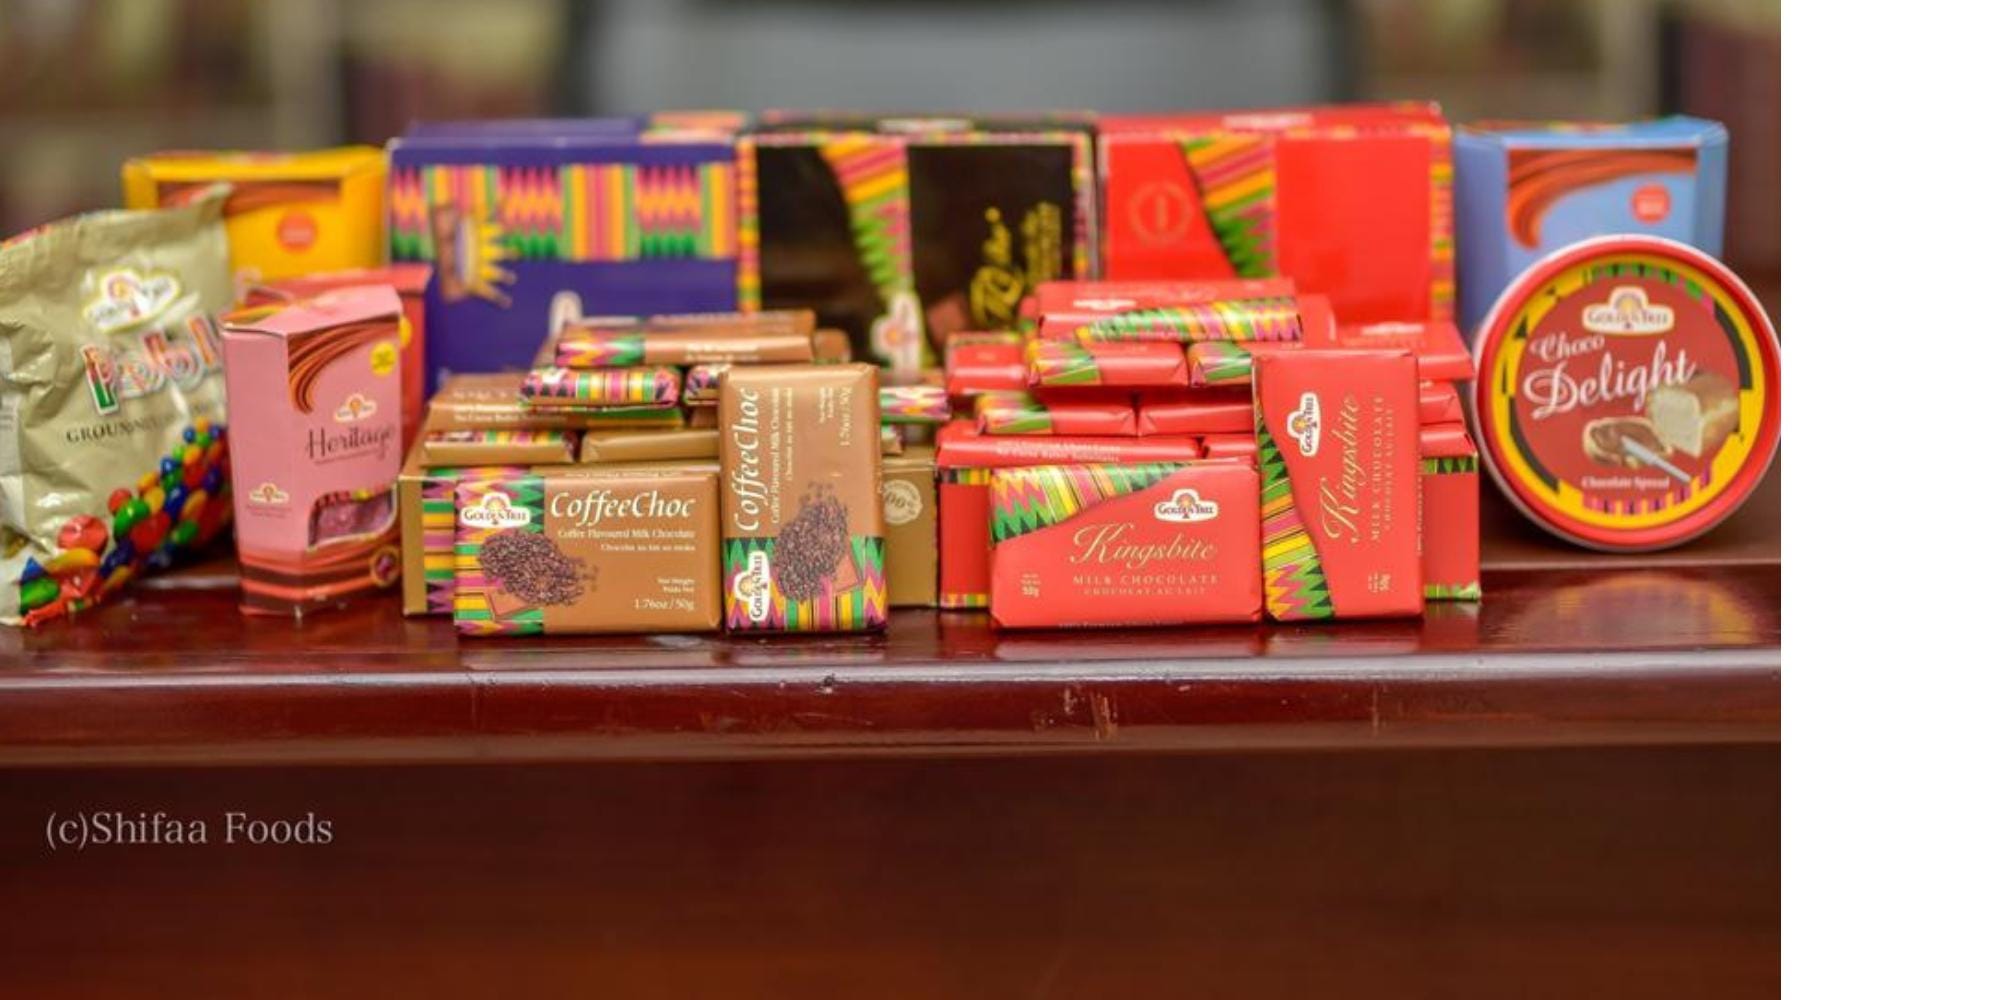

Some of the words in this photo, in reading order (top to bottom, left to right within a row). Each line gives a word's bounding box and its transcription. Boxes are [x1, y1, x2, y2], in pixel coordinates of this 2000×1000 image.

[1530, 332, 1605, 362] Choco
[1523, 340, 1697, 420] Delight
[732, 388, 768, 531] CoffeeChoc
[1371, 397, 1382, 493] CHOCOLATE
[1318, 395, 1368, 545] Kingsbite
[550, 490, 697, 527] CoffeeChoc
[1371, 498, 1382, 541] MILK
[1070, 521, 1216, 569] Kingsbite
[1073, 575, 1112, 585] MILK
[1120, 575, 1219, 585] CHOCOLATE
